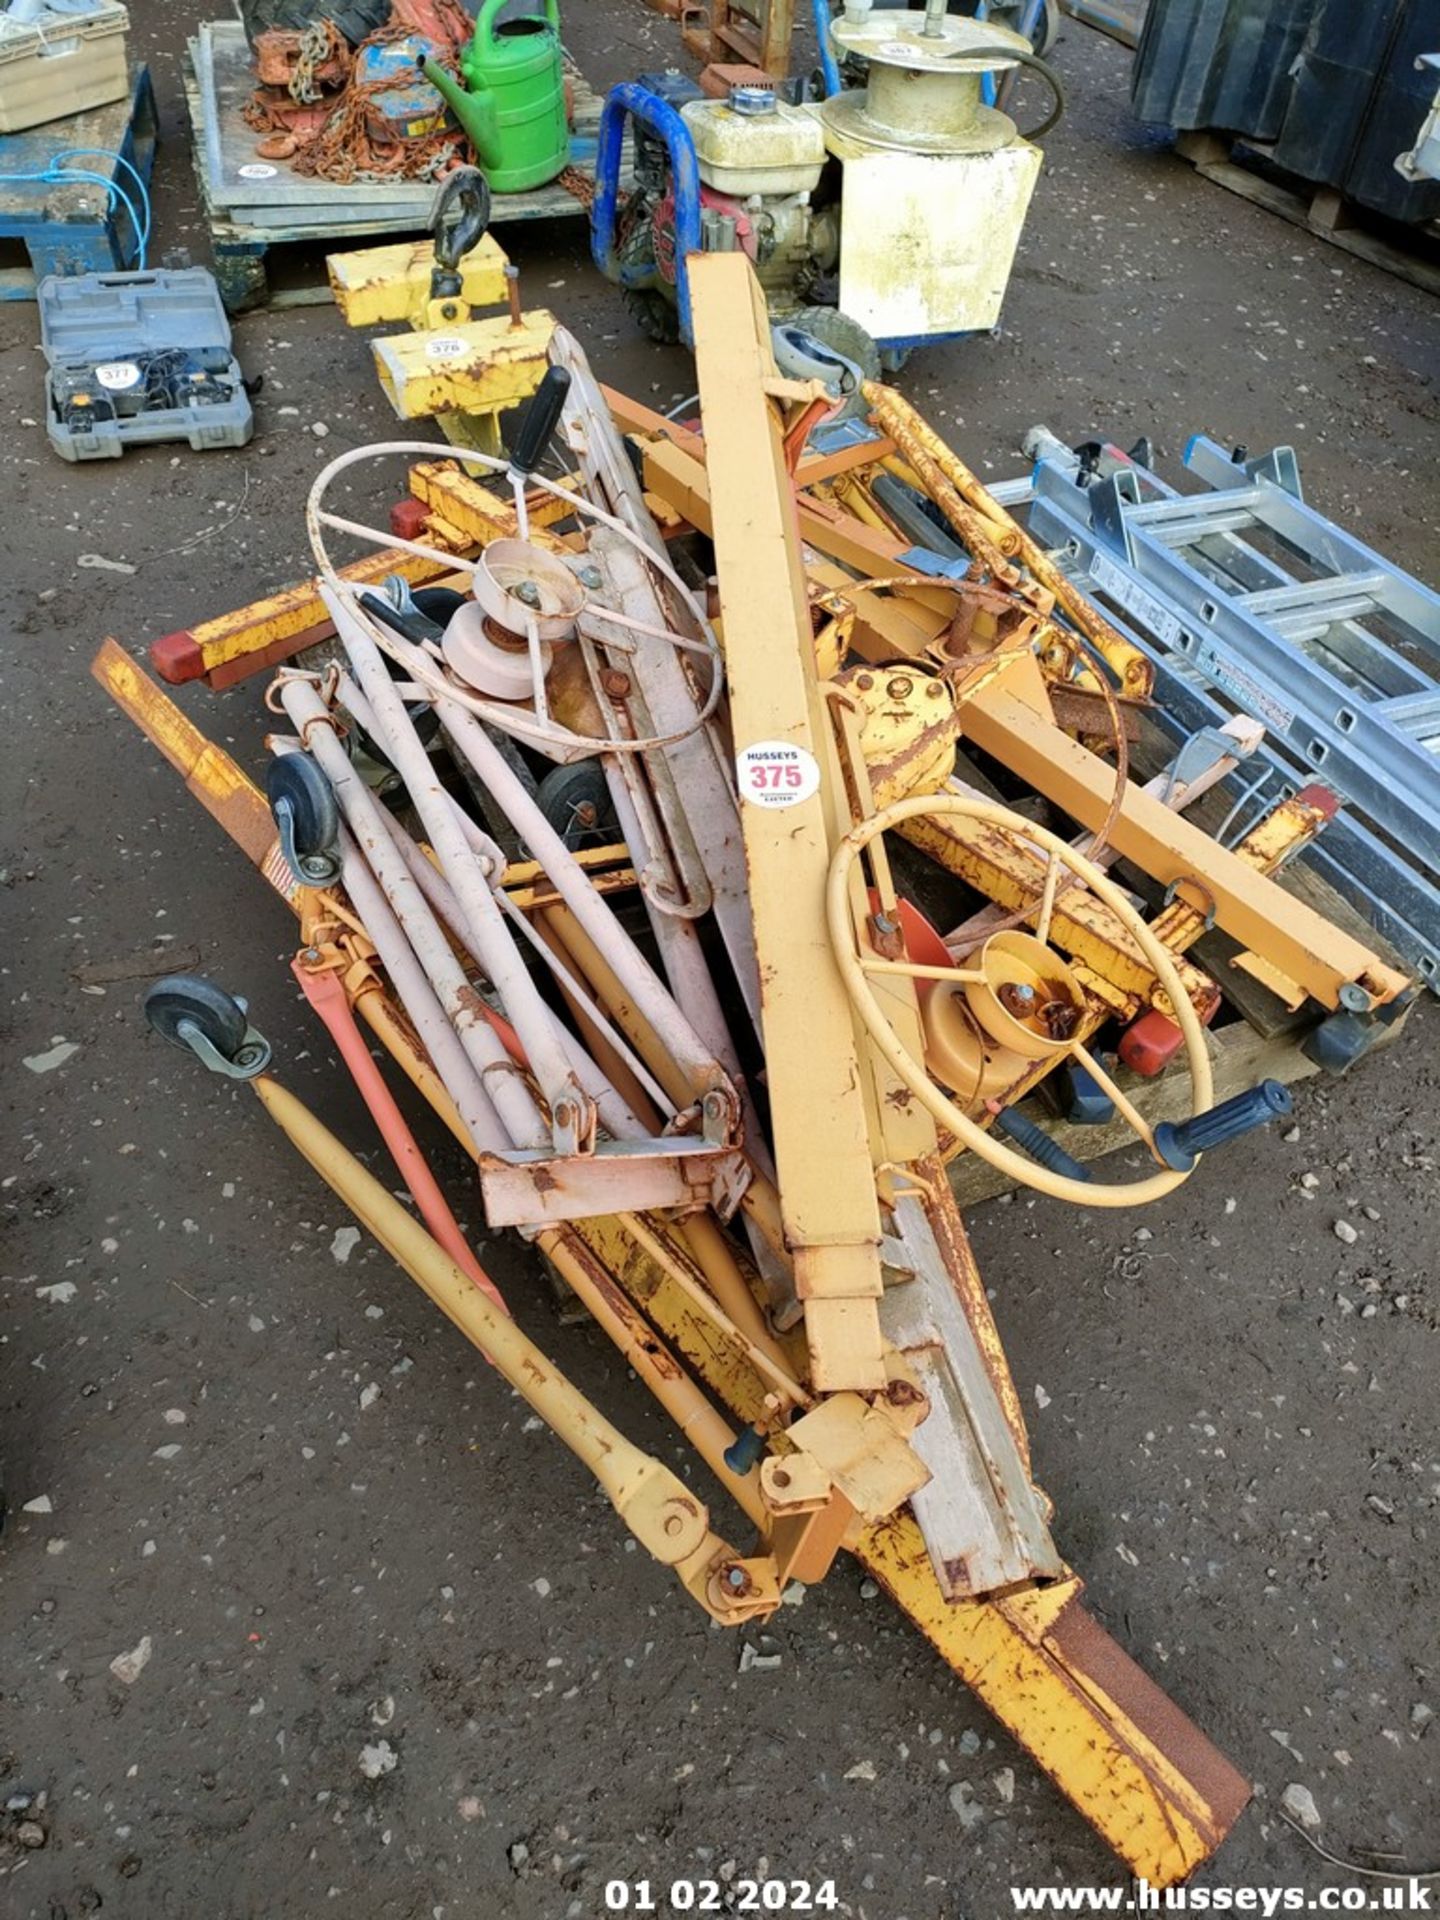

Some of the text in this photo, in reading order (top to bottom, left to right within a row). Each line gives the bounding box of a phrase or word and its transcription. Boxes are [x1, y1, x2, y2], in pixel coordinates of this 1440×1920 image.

[432, 345, 461, 354] 376
[747, 751, 798, 760] HUSSEYS
[750, 765, 802, 788] 375
